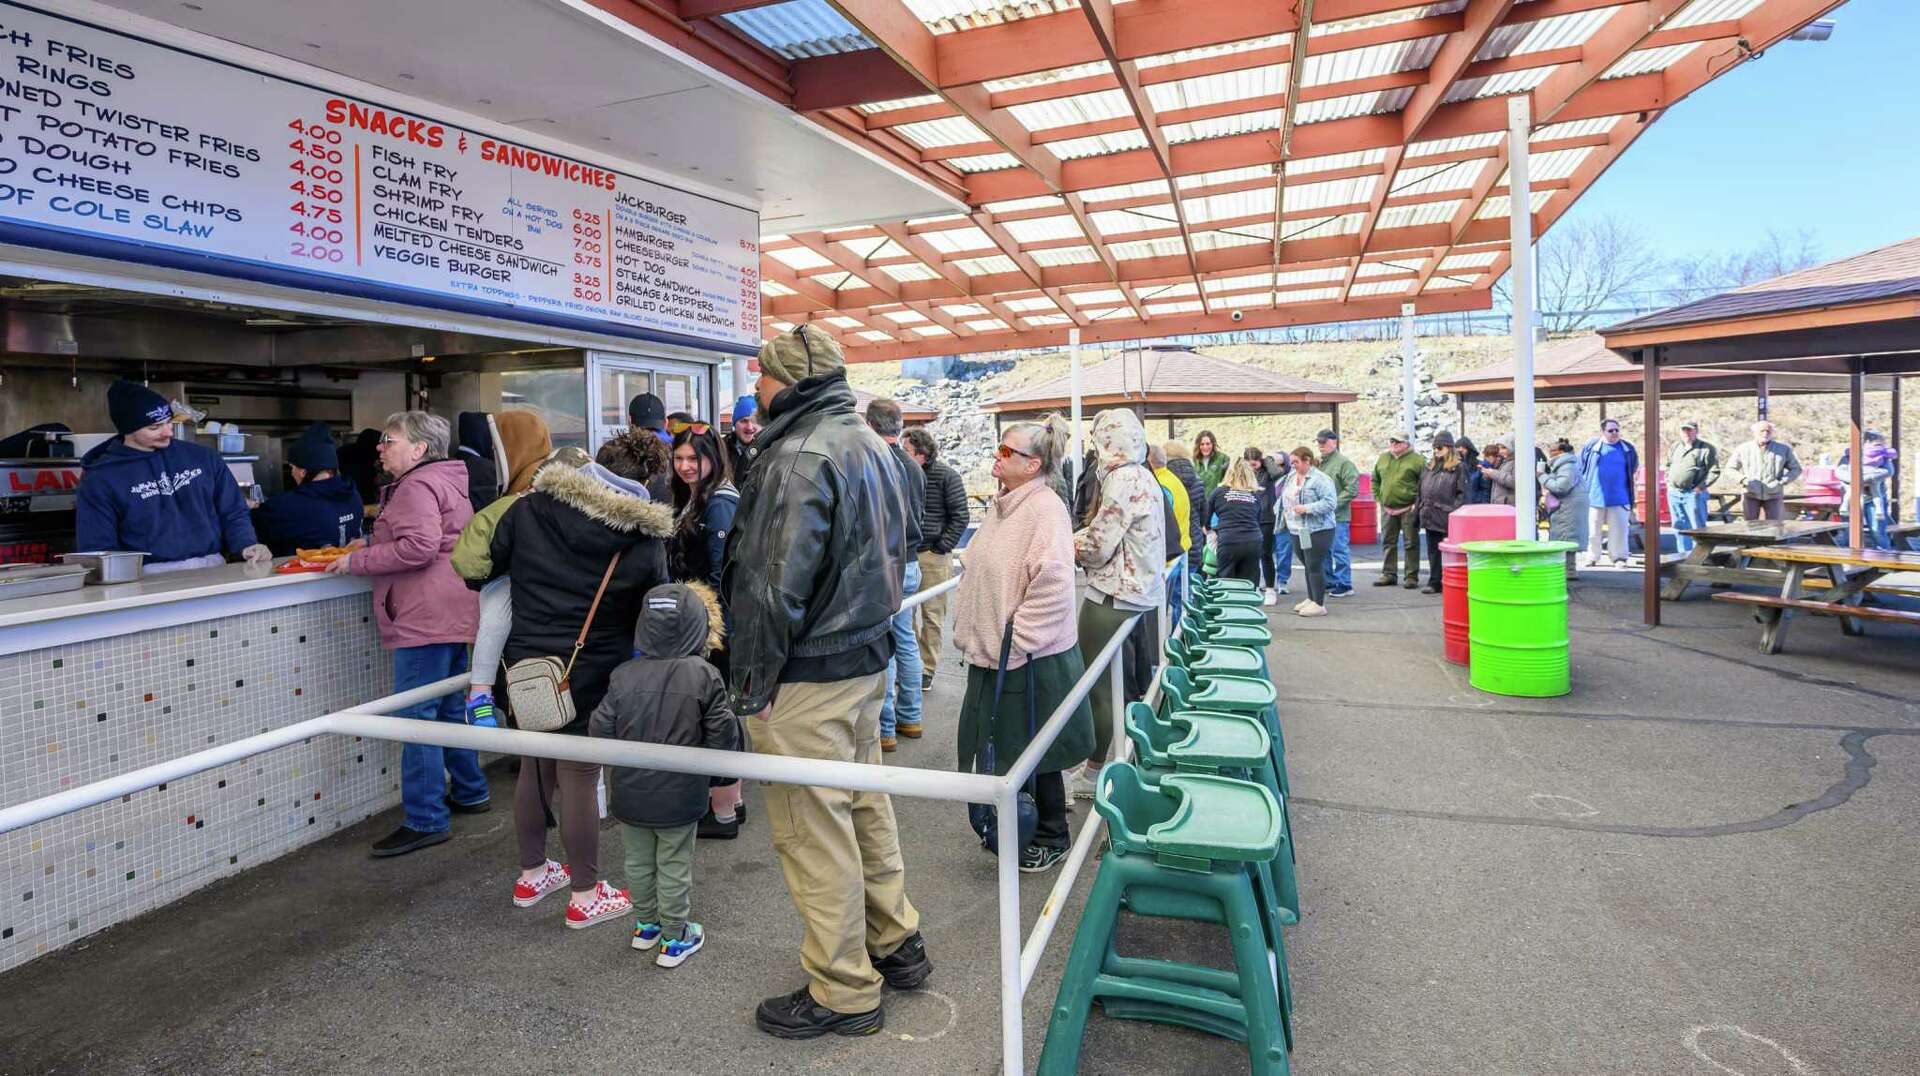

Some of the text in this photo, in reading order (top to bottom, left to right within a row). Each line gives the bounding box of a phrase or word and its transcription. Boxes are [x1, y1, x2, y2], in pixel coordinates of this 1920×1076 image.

[47, 39, 135, 80] FRIES
[16, 55, 111, 97] RINGS
[0, 78, 261, 162] NED TWISTER FRIES
[288, 118, 342, 144] 4.00
[18, 136, 131, 175] DOUGH
[36, 114, 156, 157] POTATO
[168, 148, 241, 178] FRIES
[289, 139, 343, 164] 4.50
[325, 99, 444, 148] SNACKS
[481, 140, 616, 191] SANDWICHES
[290, 159, 343, 184] 4.00
[372, 145, 458, 183] FISH FRY
[33, 167, 150, 203] CHEESE
[161, 194, 242, 222] CHIPS
[290, 180, 343, 203] 4.50
[373, 165, 463, 201] CLAM FRY
[49, 196, 130, 223] COLE
[143, 214, 214, 238] SLAW
[290, 201, 343, 224] 4.75
[373, 184, 484, 223] SHRIMP FRY
[572, 209, 601, 225] 6.25
[614, 191, 688, 226] JACKBURGER
[290, 221, 343, 244] 4.00
[373, 203, 524, 250] CHICKEN TENDERS
[573, 223, 602, 240] 6.00
[615, 226, 675, 251] HAMBURGER
[290, 242, 344, 263] 2.00
[374, 223, 559, 276] MELTED CHEESE SANDWICH
[573, 238, 601, 253] 7.00
[574, 252, 601, 268] 5.75
[615, 239, 690, 268] CHEESEBURGER
[374, 244, 511, 282] VEGGIE BURGER
[616, 254, 666, 275] HOT DOG
[573, 273, 600, 288] 3.25
[574, 287, 602, 302] 5.00
[616, 268, 701, 296] STEAK SANDWICH
[616, 281, 661, 300] SAUSAGE
[664, 293, 670, 302] &
[672, 294, 713, 312] PEPPERS
[616, 295, 656, 311] GRILLED
[659, 304, 695, 320] CHICKEN
[697, 312, 735, 328] SANDWICH
